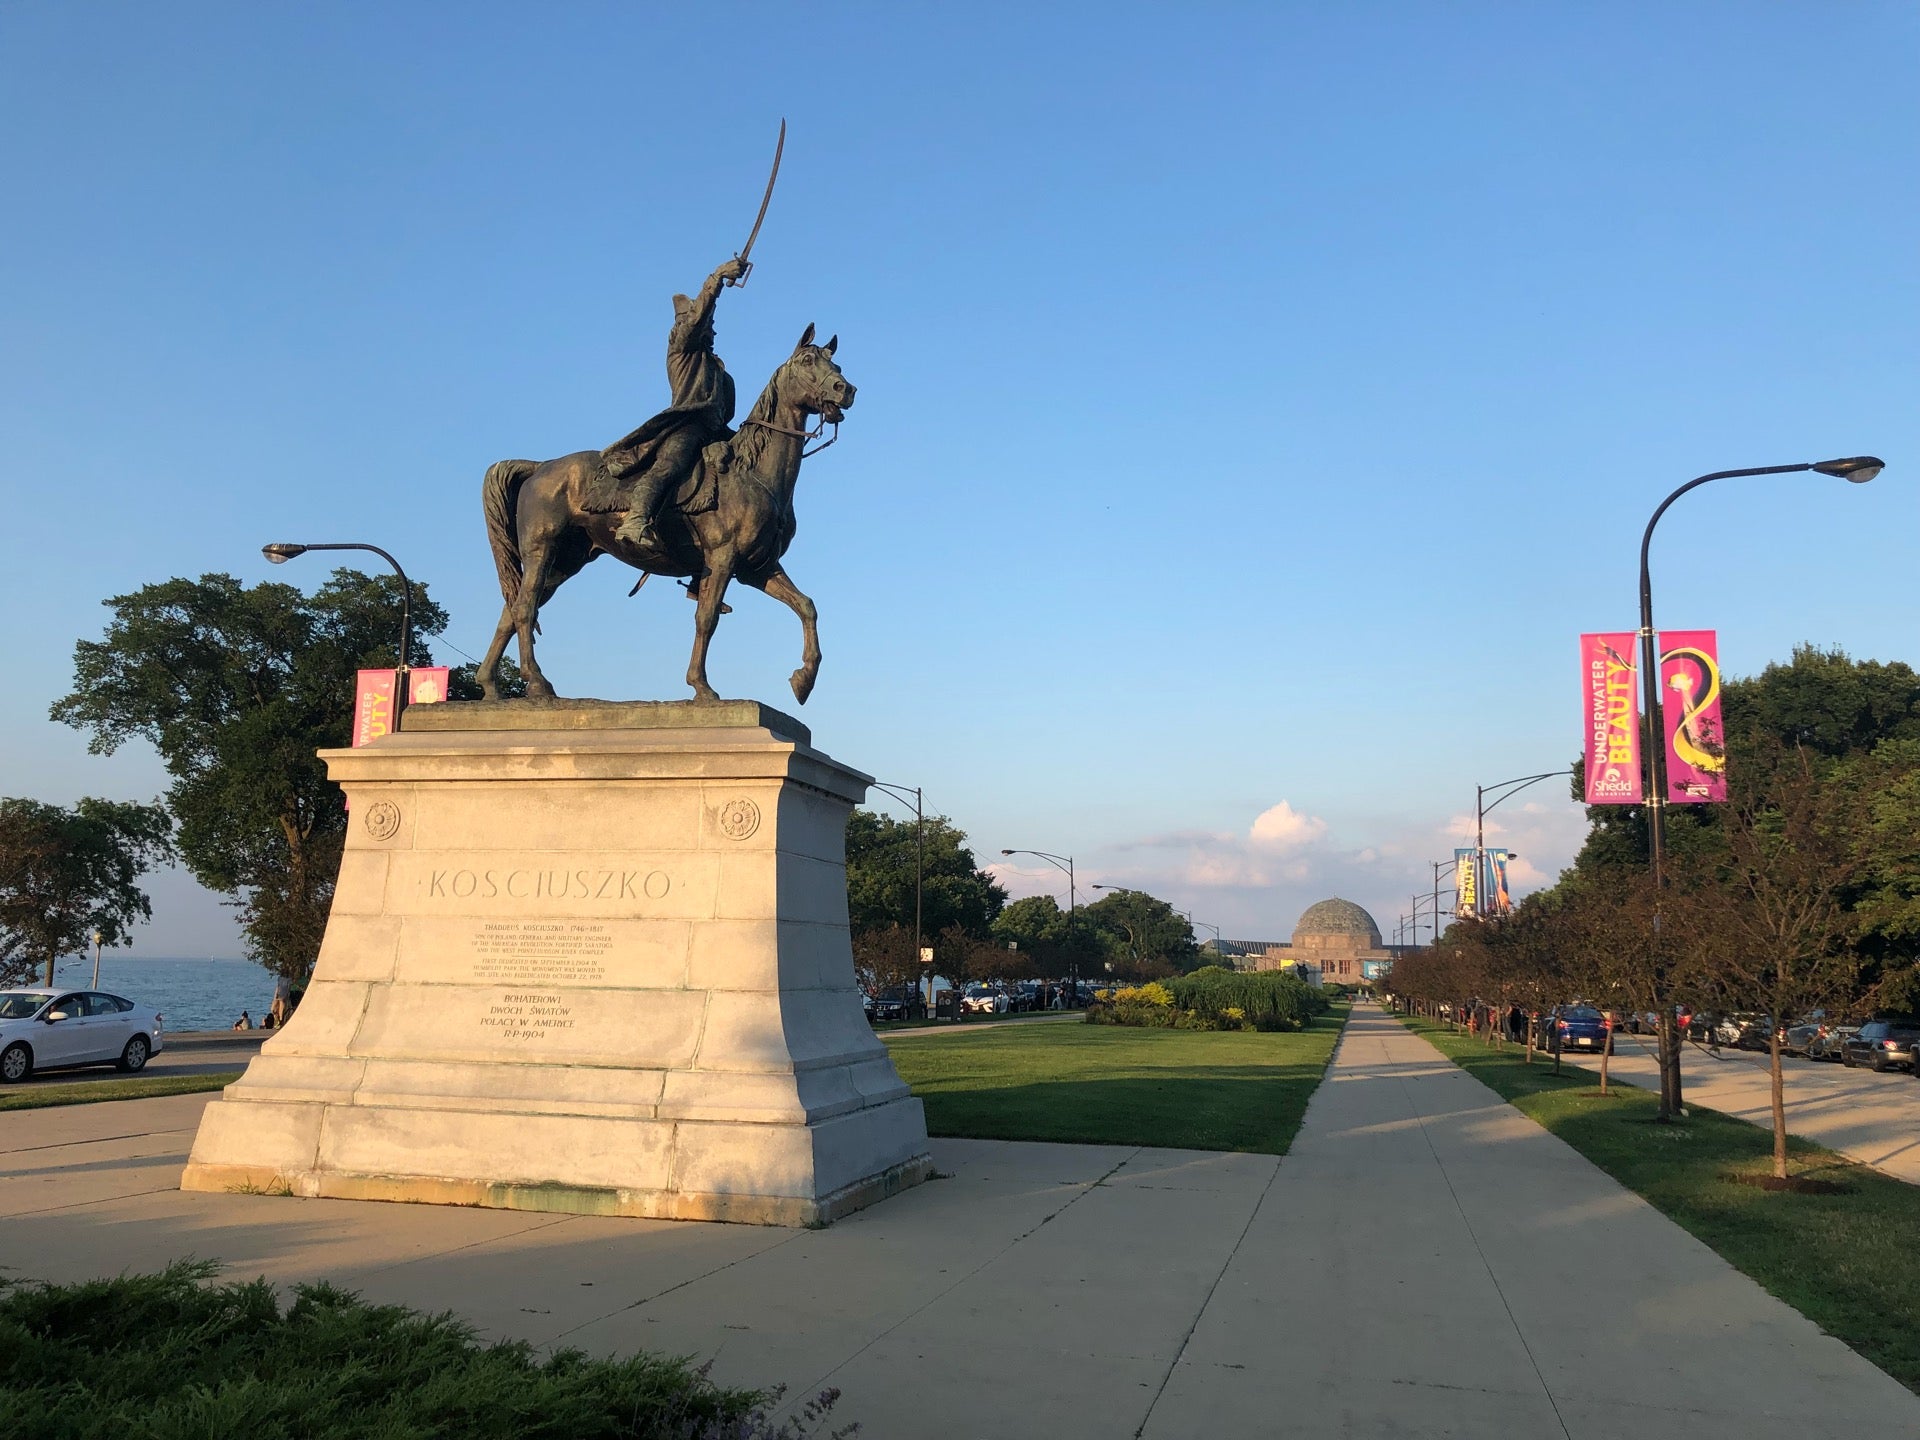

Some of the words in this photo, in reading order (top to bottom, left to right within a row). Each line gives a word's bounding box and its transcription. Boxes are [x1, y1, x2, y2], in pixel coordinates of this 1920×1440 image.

[1592, 660, 1607, 764] UNDERWATER
[1606, 660, 1632, 764] BEAUTY
[1594, 780, 1632, 792] Shedd
[430, 870, 671, 899] KOSCIUSZKO
[1464, 861, 1475, 904] BEAUTY
[523, 924, 564, 932] KOSCIUSZKO
[504, 994, 561, 1004] BOHATEROWI
[480, 1018, 516, 1026] POLACY
[519, 1018, 529, 1026] W
[533, 1019, 576, 1028] AMERYCE
